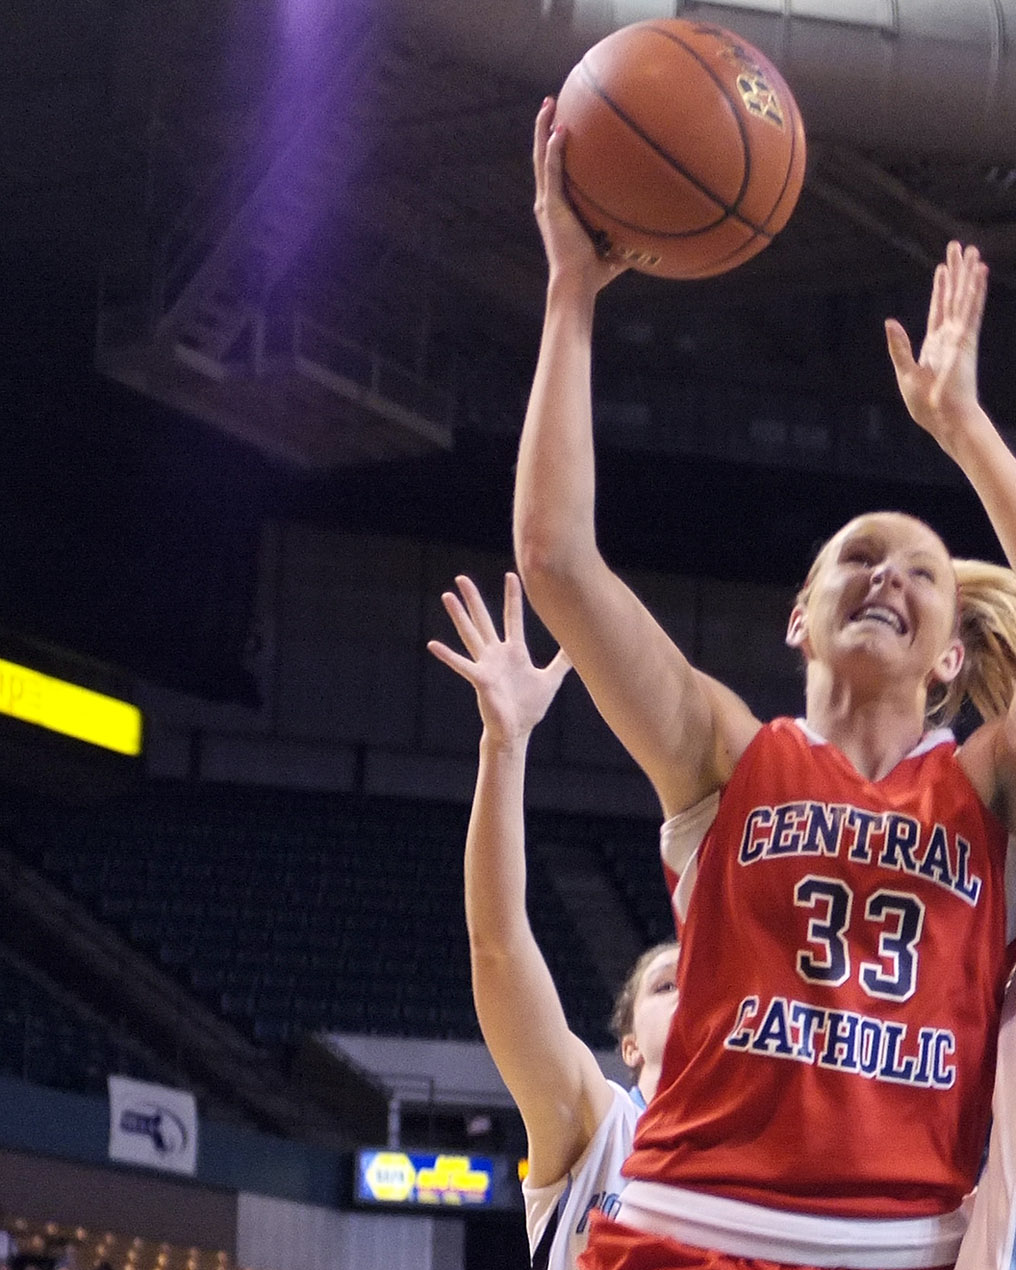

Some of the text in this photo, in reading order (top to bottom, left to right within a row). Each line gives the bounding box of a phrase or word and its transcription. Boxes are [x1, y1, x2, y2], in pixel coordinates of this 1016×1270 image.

[738, 800, 982, 908] CENTRAL
[794, 874, 925, 1003] 33
[724, 995, 956, 1090] CATHOLIC
